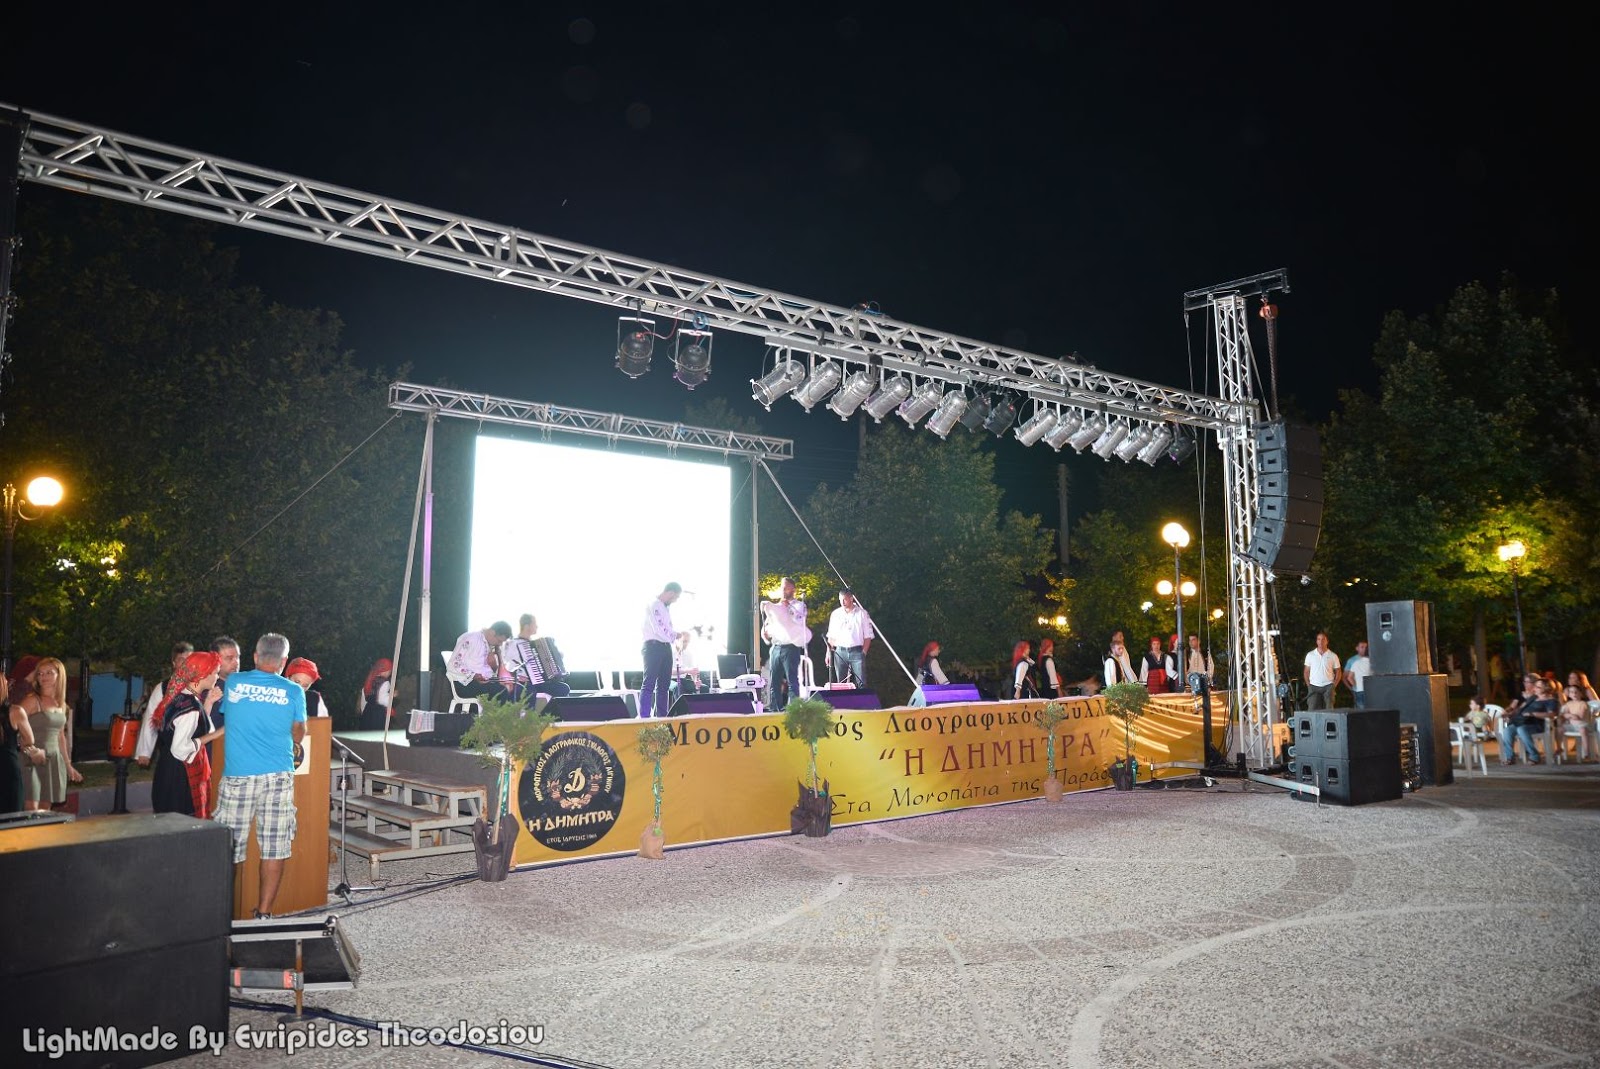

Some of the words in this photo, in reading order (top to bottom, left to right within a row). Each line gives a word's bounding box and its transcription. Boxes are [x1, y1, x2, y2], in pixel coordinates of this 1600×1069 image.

[249, 693, 289, 705] SOUND
[668, 715, 863, 749] Μορφωός
[885, 705, 1044, 734] Λαογραφικός
[830, 794, 871, 815] Στα
[528, 818, 541, 832] Η
[544, 810, 614, 831] ΔΗΜΗΤΡΑ
